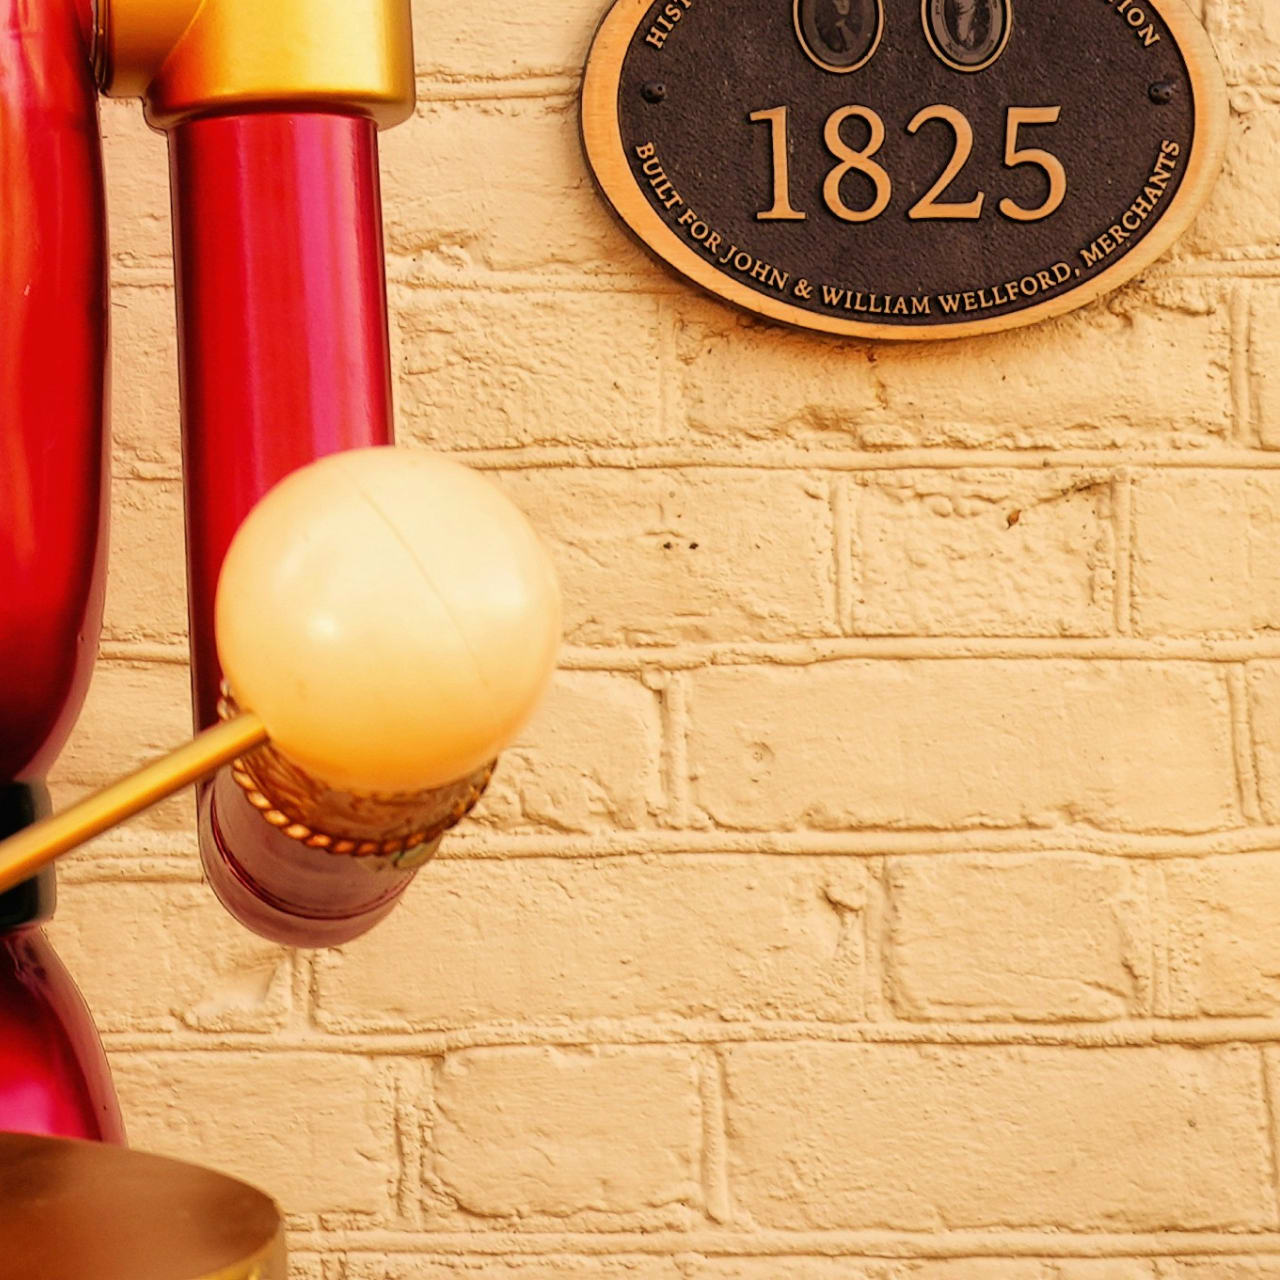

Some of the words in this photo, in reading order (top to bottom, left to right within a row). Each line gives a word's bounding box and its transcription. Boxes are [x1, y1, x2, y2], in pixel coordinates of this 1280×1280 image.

[635, 141, 684, 210] BUILT
[677, 207, 725, 254] FOR
[720, 244, 790, 290] JOHN
[793, 278, 813, 299] &
[822, 284, 931, 315] WILLIAM
[937, 261, 1081, 313] WELLFORD,
[1079, 140, 1181, 269] MERCHANTS
[749, 103, 1067, 223] 1825
